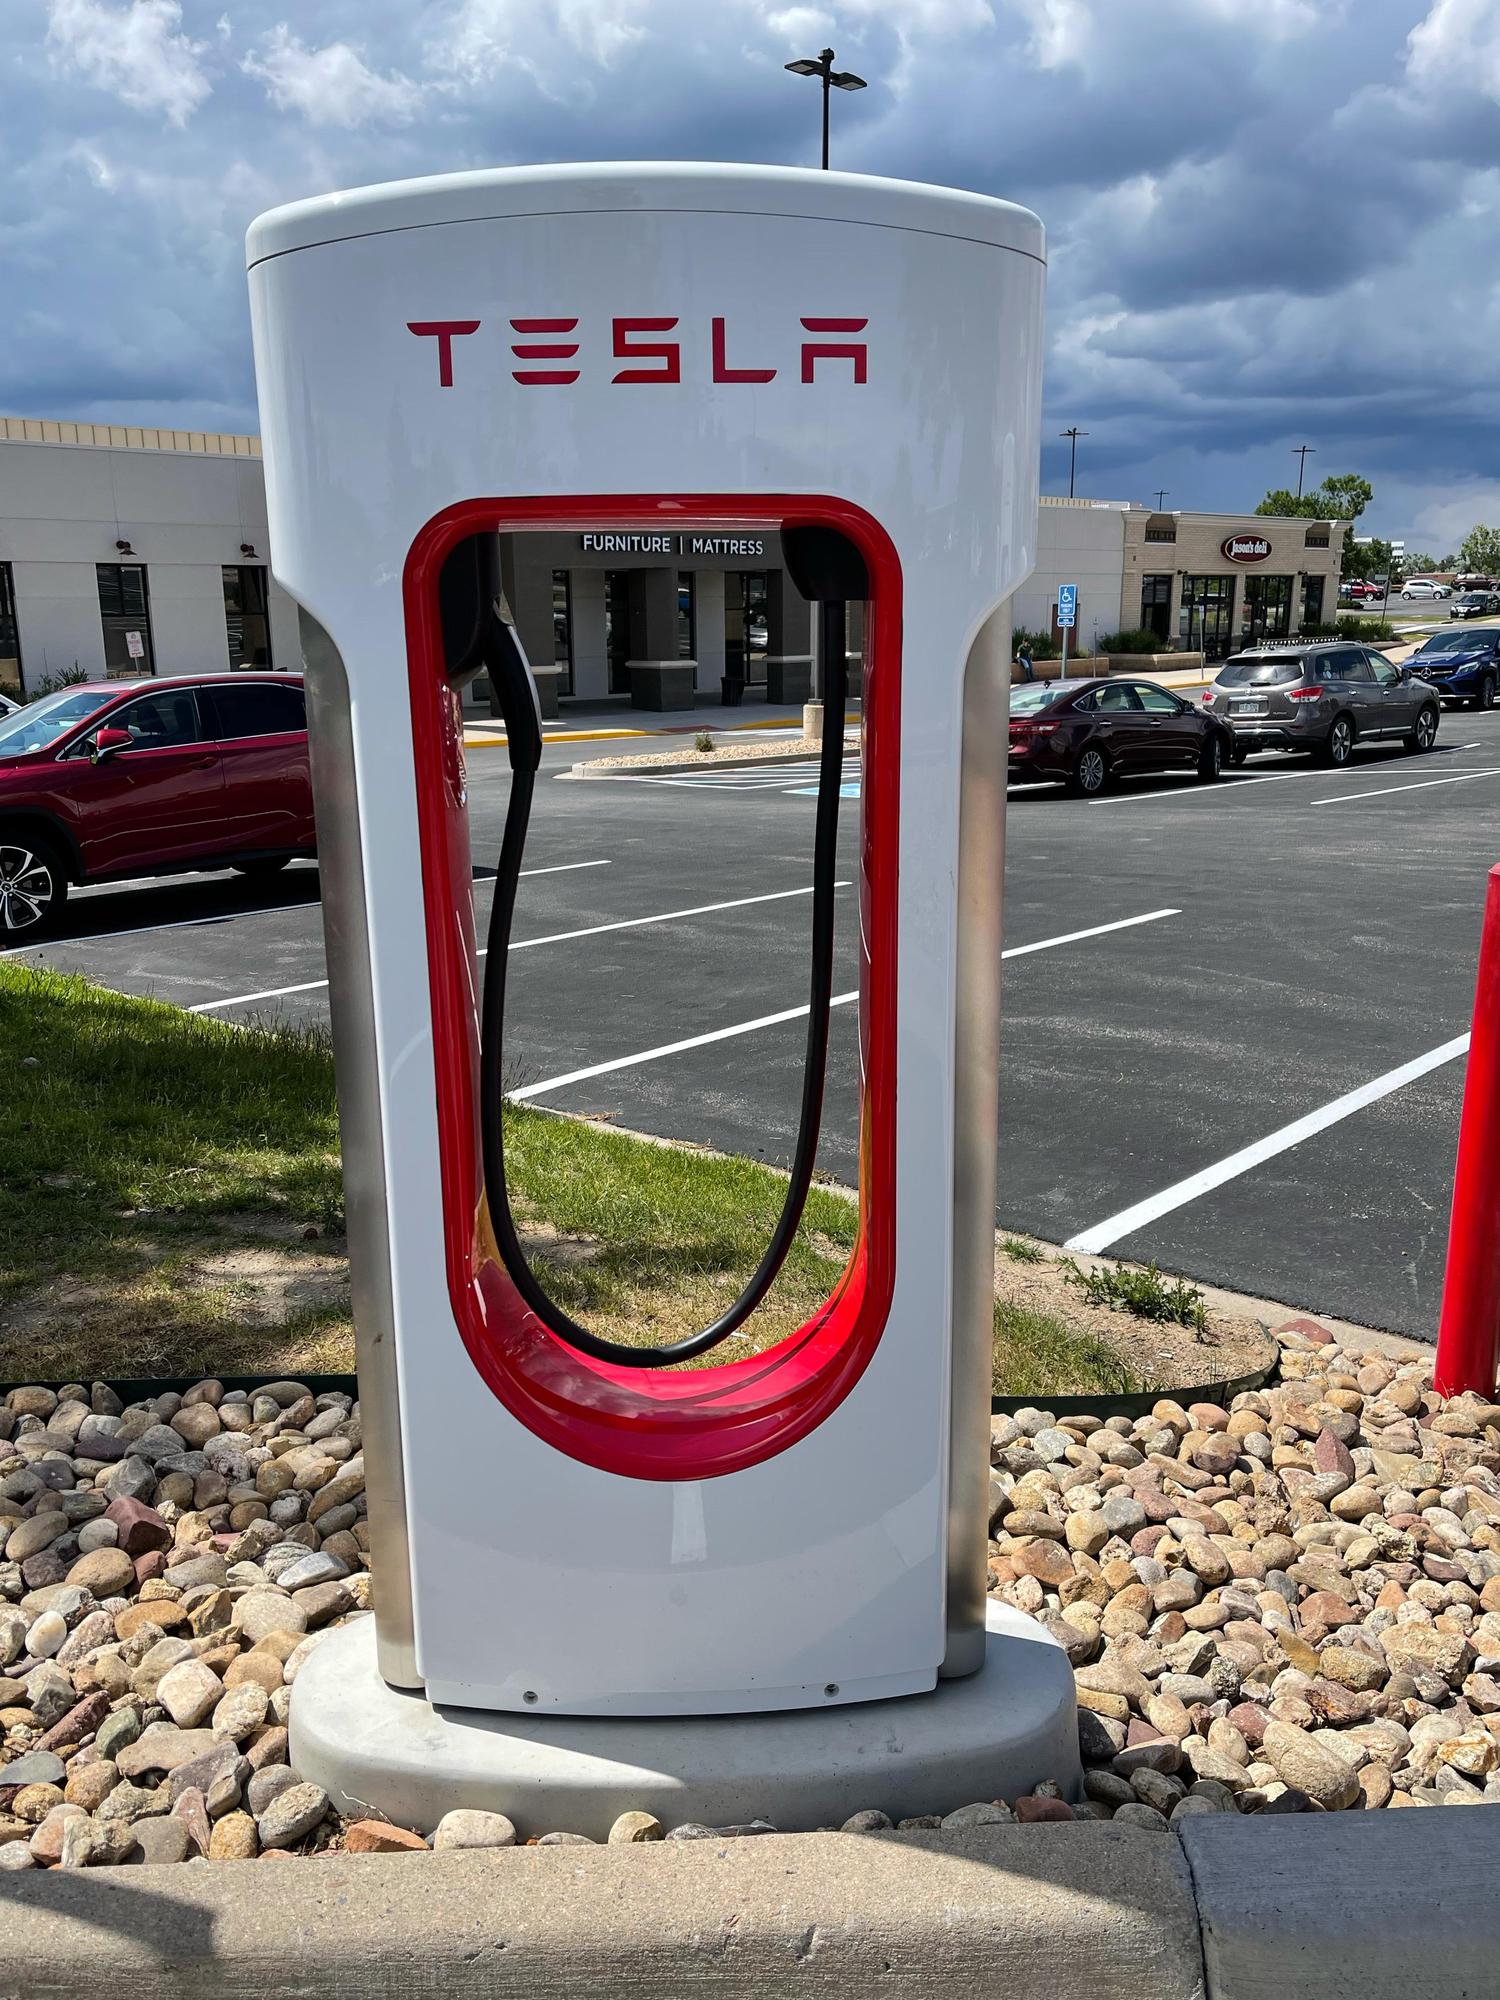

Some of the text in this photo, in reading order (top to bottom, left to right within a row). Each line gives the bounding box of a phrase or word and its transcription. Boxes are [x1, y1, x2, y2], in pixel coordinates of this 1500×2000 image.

[407, 317, 868, 387] TESLA
[583, 534, 763, 556] FURNITURE MATTRESS
[1231, 540, 1254, 556] Jason's
